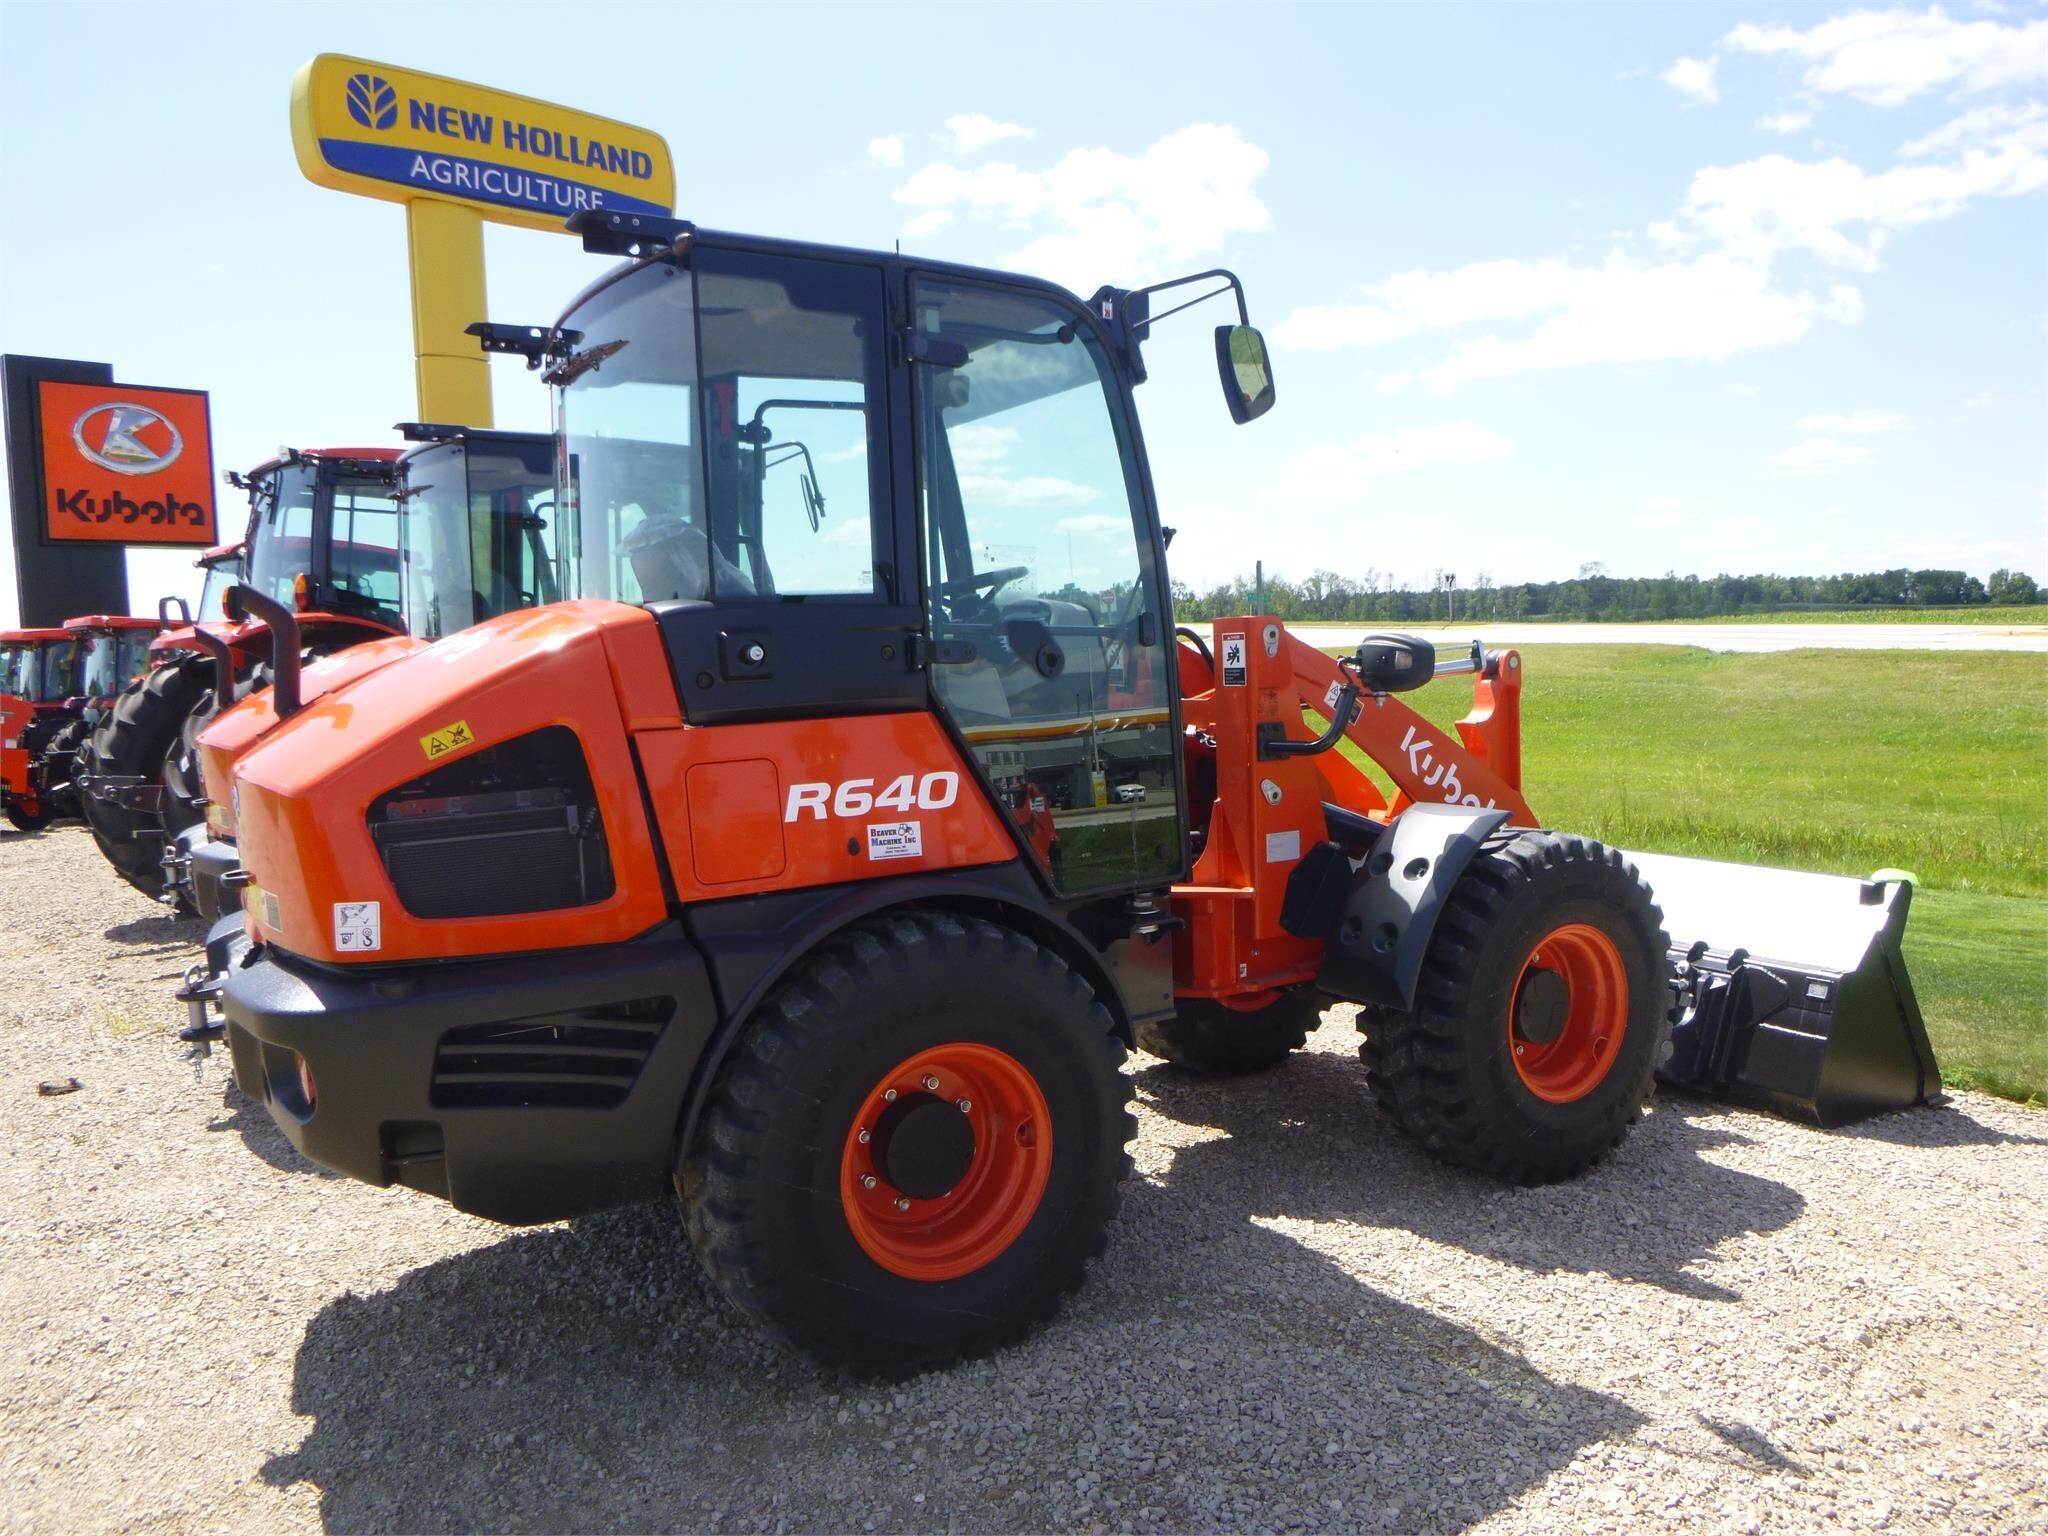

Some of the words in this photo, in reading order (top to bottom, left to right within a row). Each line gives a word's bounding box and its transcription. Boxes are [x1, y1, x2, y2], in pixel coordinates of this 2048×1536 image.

[409, 98, 493, 145] NEW
[503, 119, 653, 180] HOLLAND
[56, 488, 205, 526] Kubota
[784, 771, 959, 823] R640
[1400, 725, 1496, 810] Kubo
